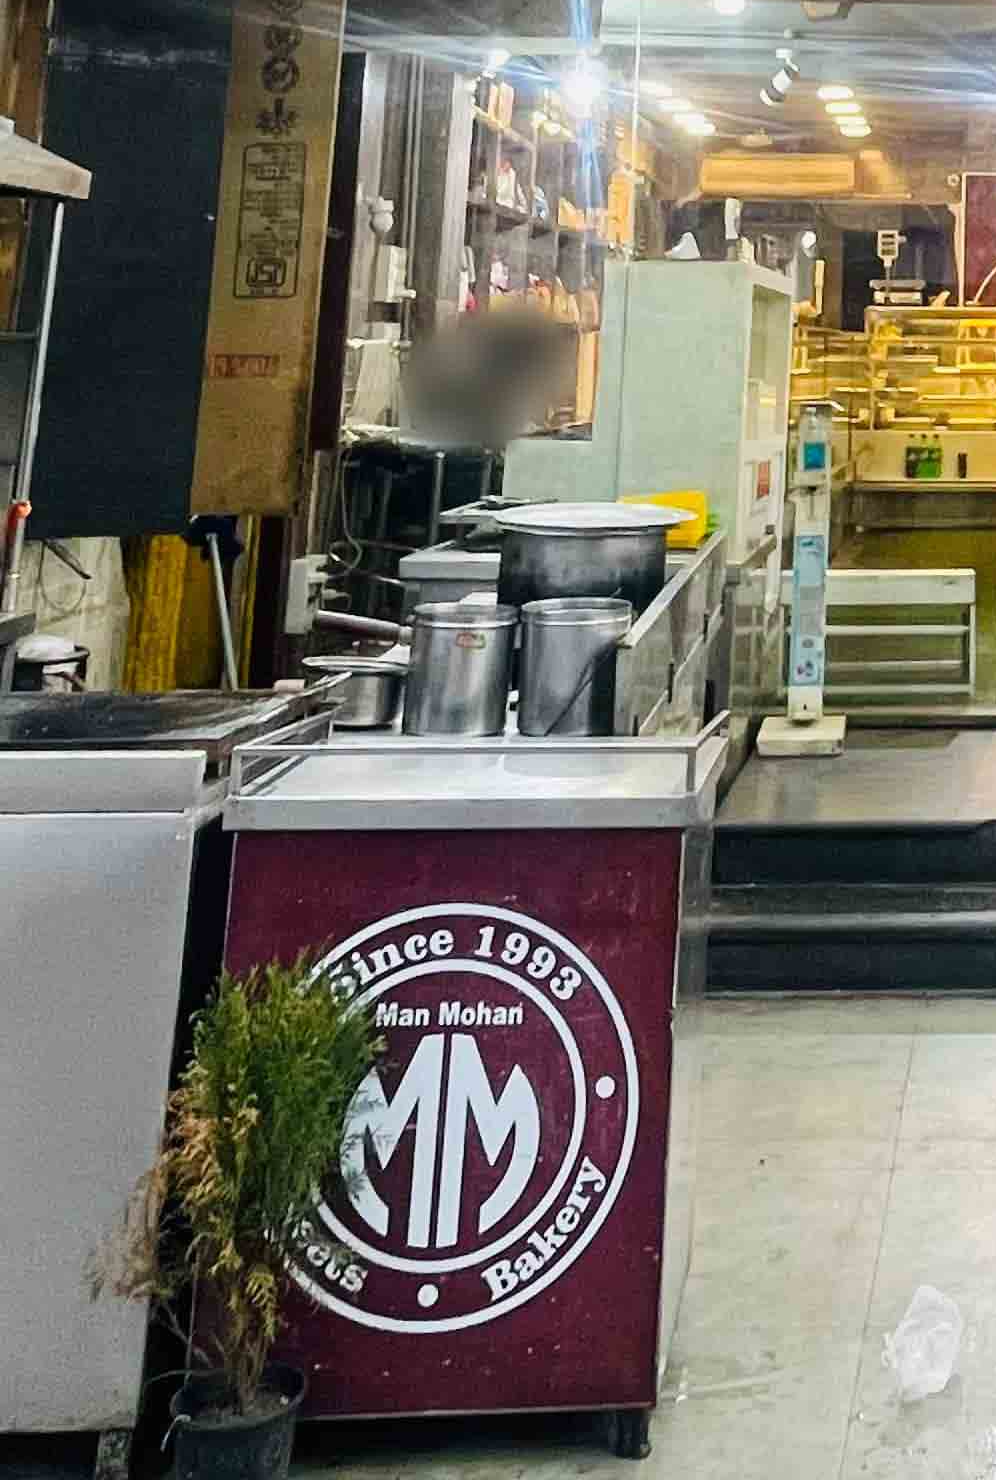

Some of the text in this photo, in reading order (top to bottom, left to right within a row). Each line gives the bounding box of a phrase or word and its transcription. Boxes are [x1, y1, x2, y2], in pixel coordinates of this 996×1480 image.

[376, 1000, 523, 1027] Man Mohan
[474, 925, 584, 1001] 1993
[339, 1032, 541, 1249] MM
[481, 1155, 606, 1303] Bakery
